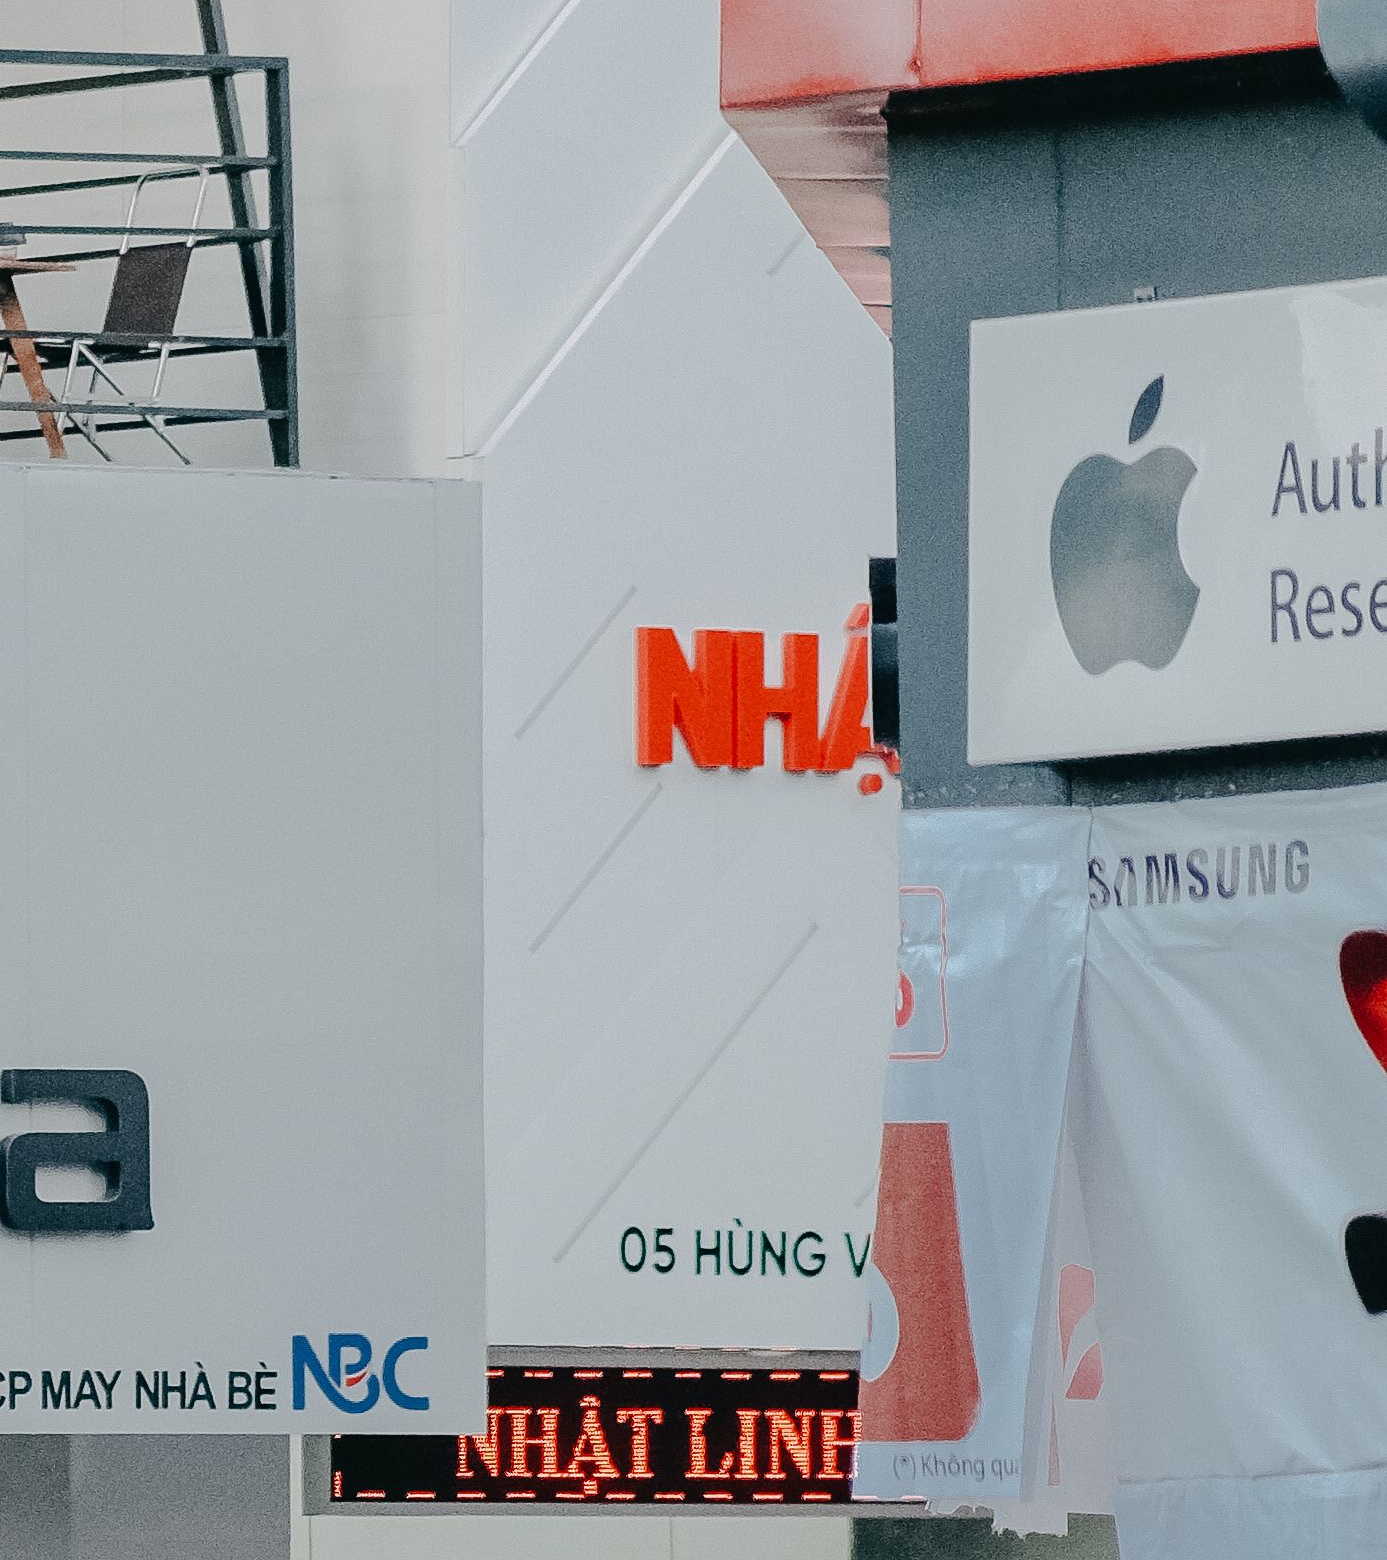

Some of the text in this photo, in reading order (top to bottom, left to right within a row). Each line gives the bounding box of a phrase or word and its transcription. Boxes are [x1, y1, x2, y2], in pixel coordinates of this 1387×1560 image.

[1088, 838, 1311, 910] SAMSUNG
[619, 1226, 676, 1274] 05
[695, 1218, 827, 1277] HÙNG
[41, 1370, 121, 1410] MAY
[134, 1362, 217, 1411] NHÀ
[227, 1361, 276, 1411] BÈ
[920, 1451, 985, 1482] Không
